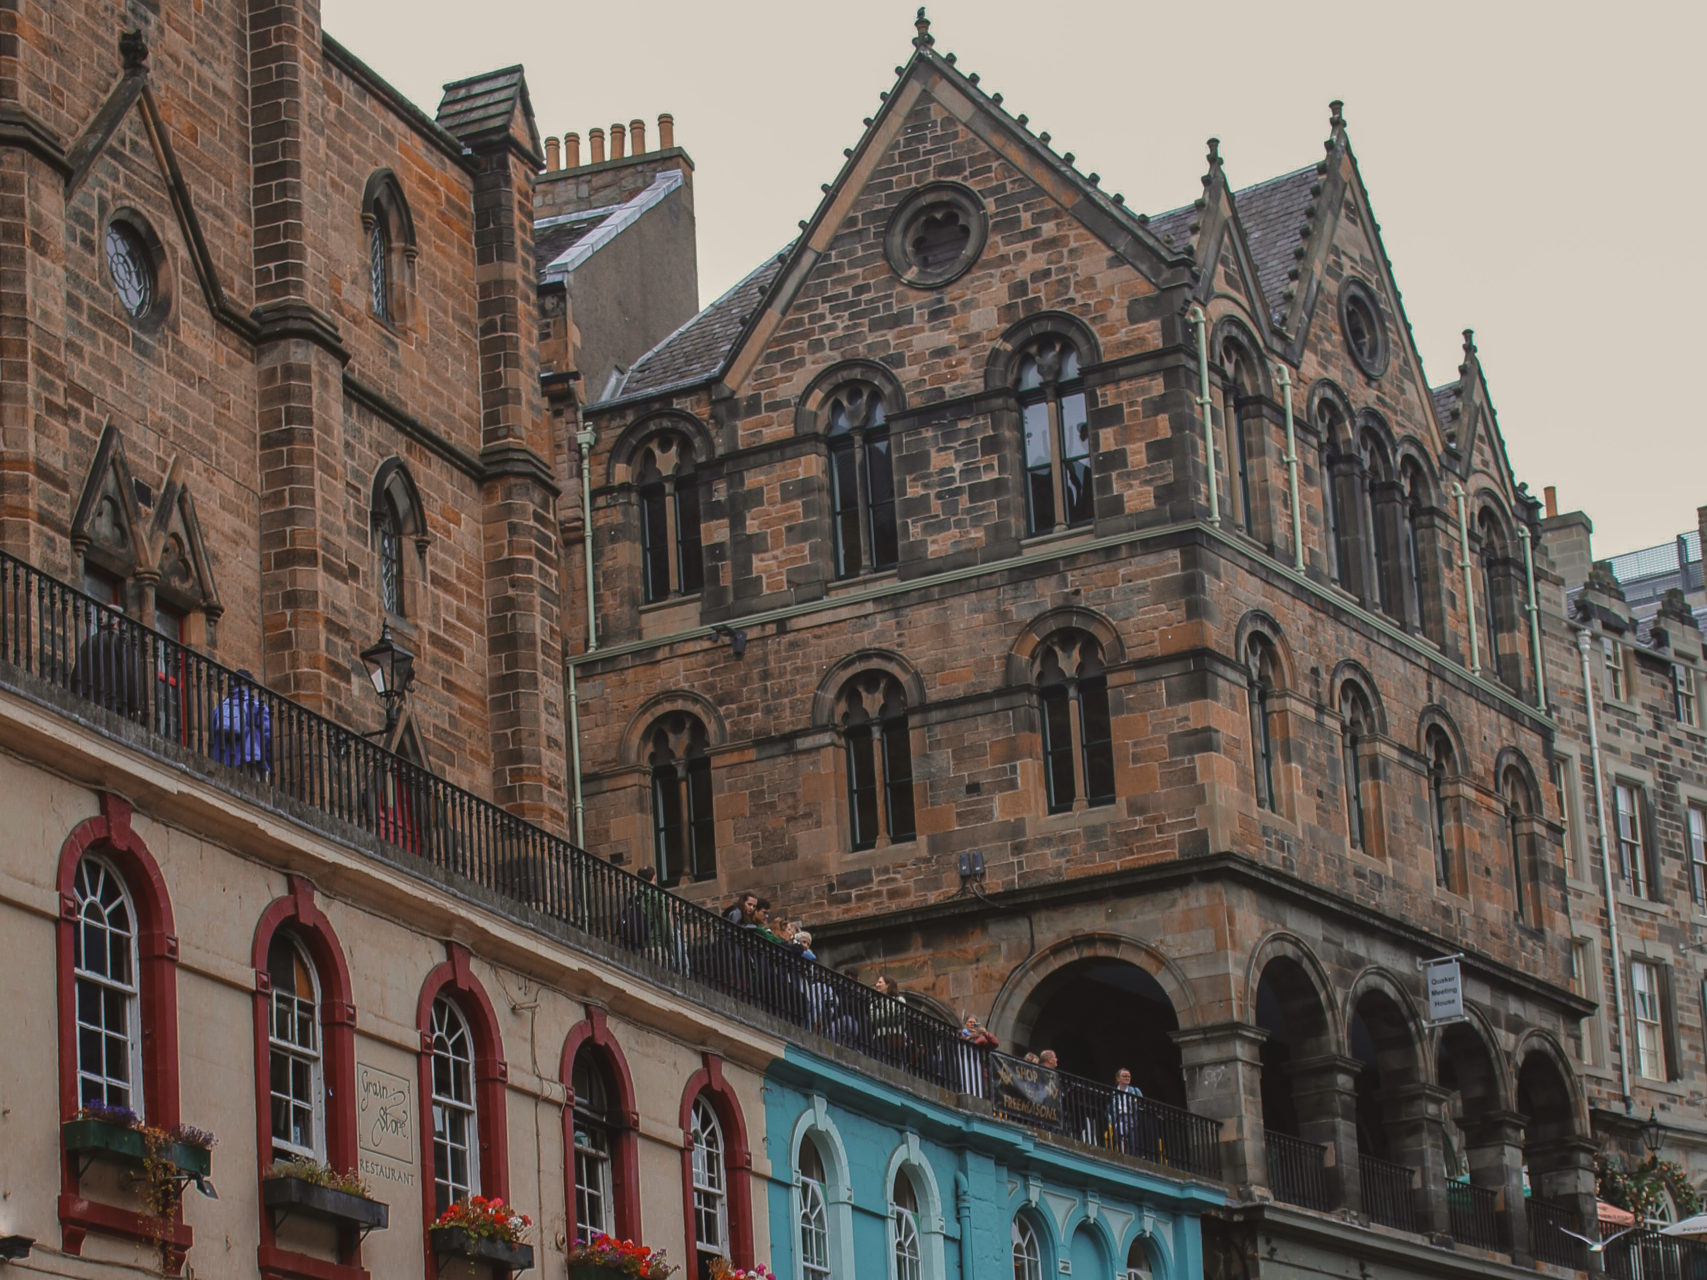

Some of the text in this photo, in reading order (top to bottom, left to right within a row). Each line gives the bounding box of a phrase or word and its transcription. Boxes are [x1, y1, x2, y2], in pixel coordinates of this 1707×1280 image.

[1431, 977, 1455, 986] Quaker
[1431, 987, 1457, 997] Meeting
[1434, 999, 1456, 1007] House
[1015, 1066, 1038, 1083] SHOP
[361, 1070, 390, 1111] Grain
[1003, 1095, 1057, 1120] FREEMASONS
[360, 1158, 415, 1186] RESTAURANT
